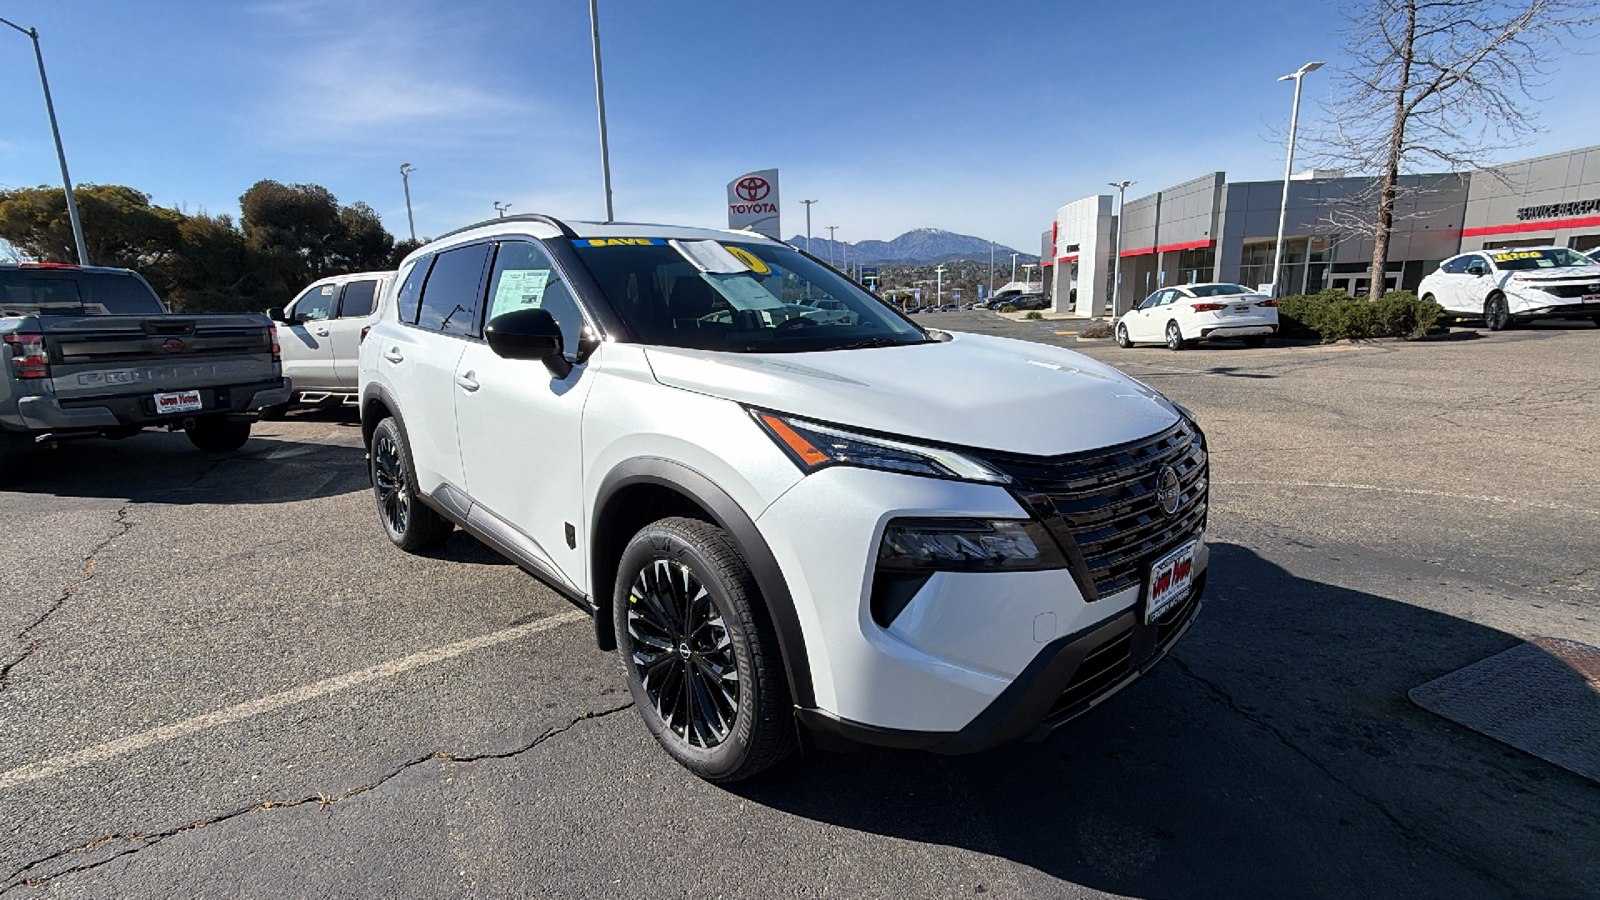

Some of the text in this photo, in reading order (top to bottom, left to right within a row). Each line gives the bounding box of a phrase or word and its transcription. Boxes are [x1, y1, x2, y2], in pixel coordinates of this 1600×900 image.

[730, 203, 777, 214] TOYOTA
[1516, 204, 1559, 220] SERVICE
[588, 238, 653, 247] SAVE
[1157, 488, 1179, 501] NISS
